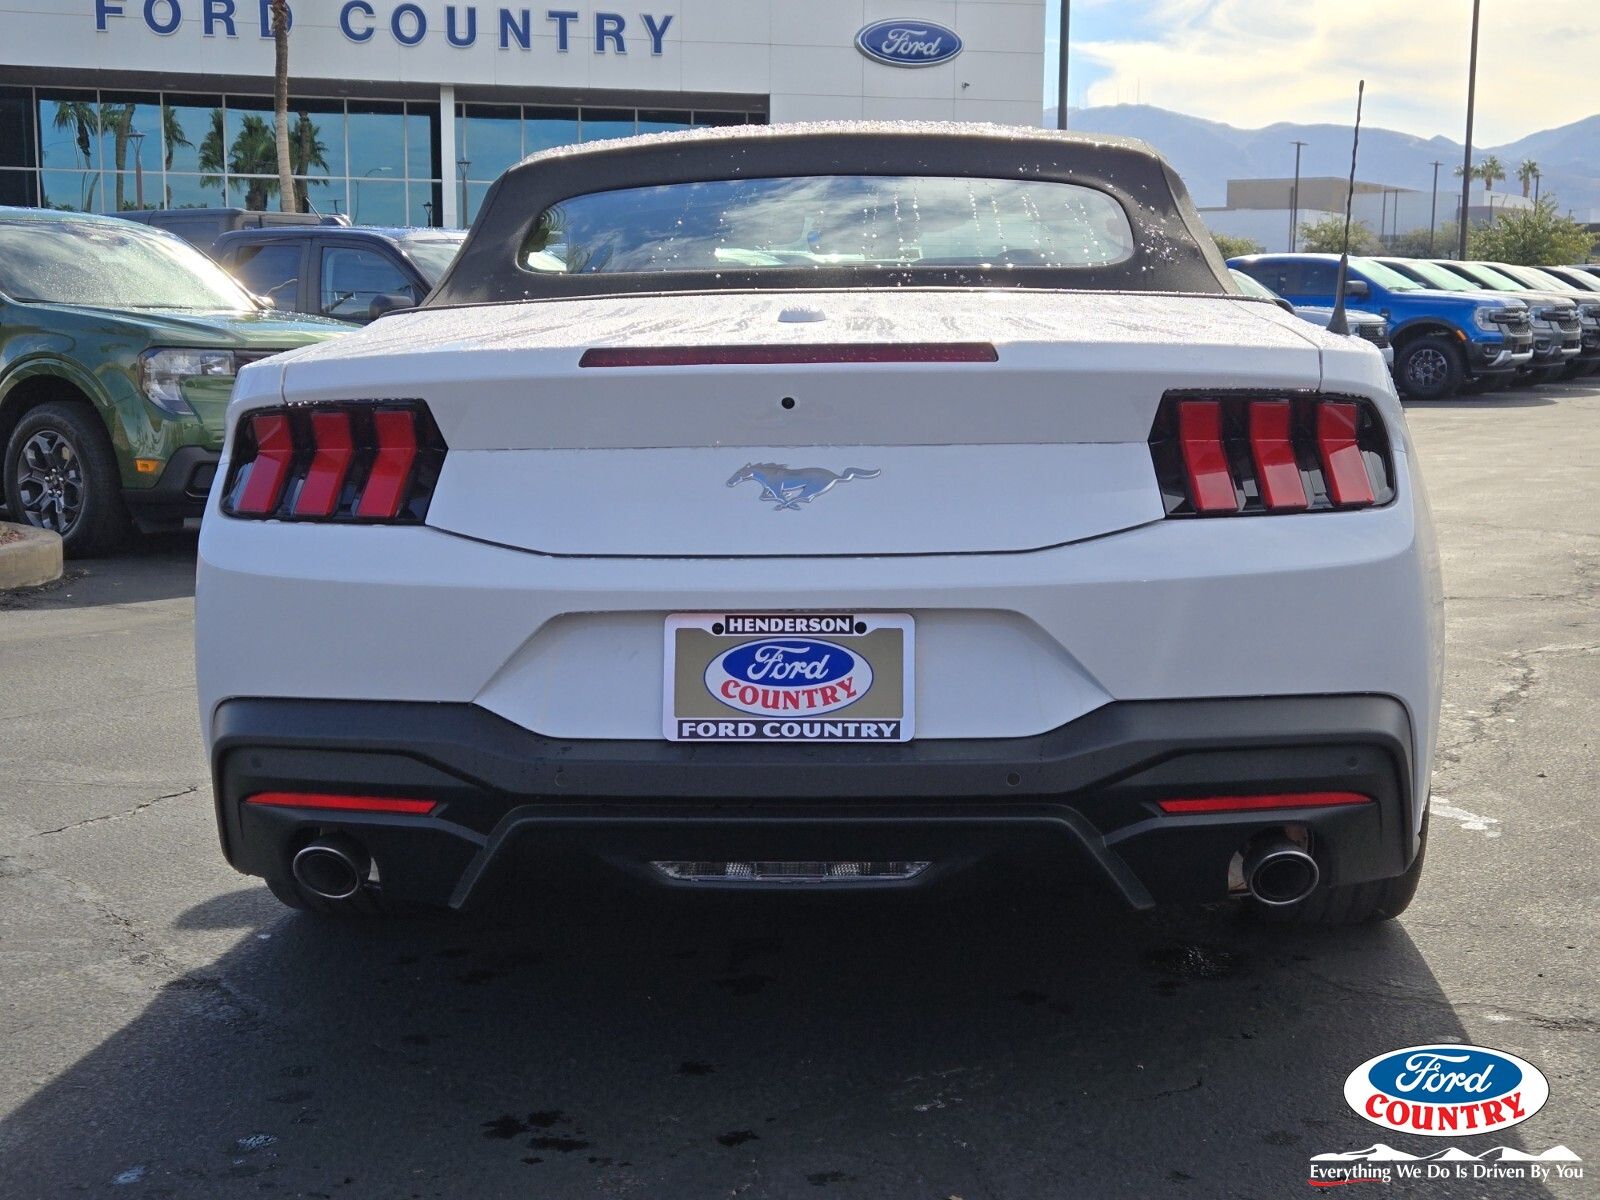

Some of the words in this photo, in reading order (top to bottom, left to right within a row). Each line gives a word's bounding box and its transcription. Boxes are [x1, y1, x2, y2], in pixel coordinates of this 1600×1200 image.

[96, 0, 294, 39] FORD
[339, 0, 674, 55] COUNTRY
[881, 28, 942, 55] Ford
[728, 618, 851, 632] HENDERSON
[747, 645, 830, 680] Ford
[720, 676, 857, 710] COUNTRY
[681, 722, 757, 737] FORD
[762, 722, 897, 738] COUNTRY
